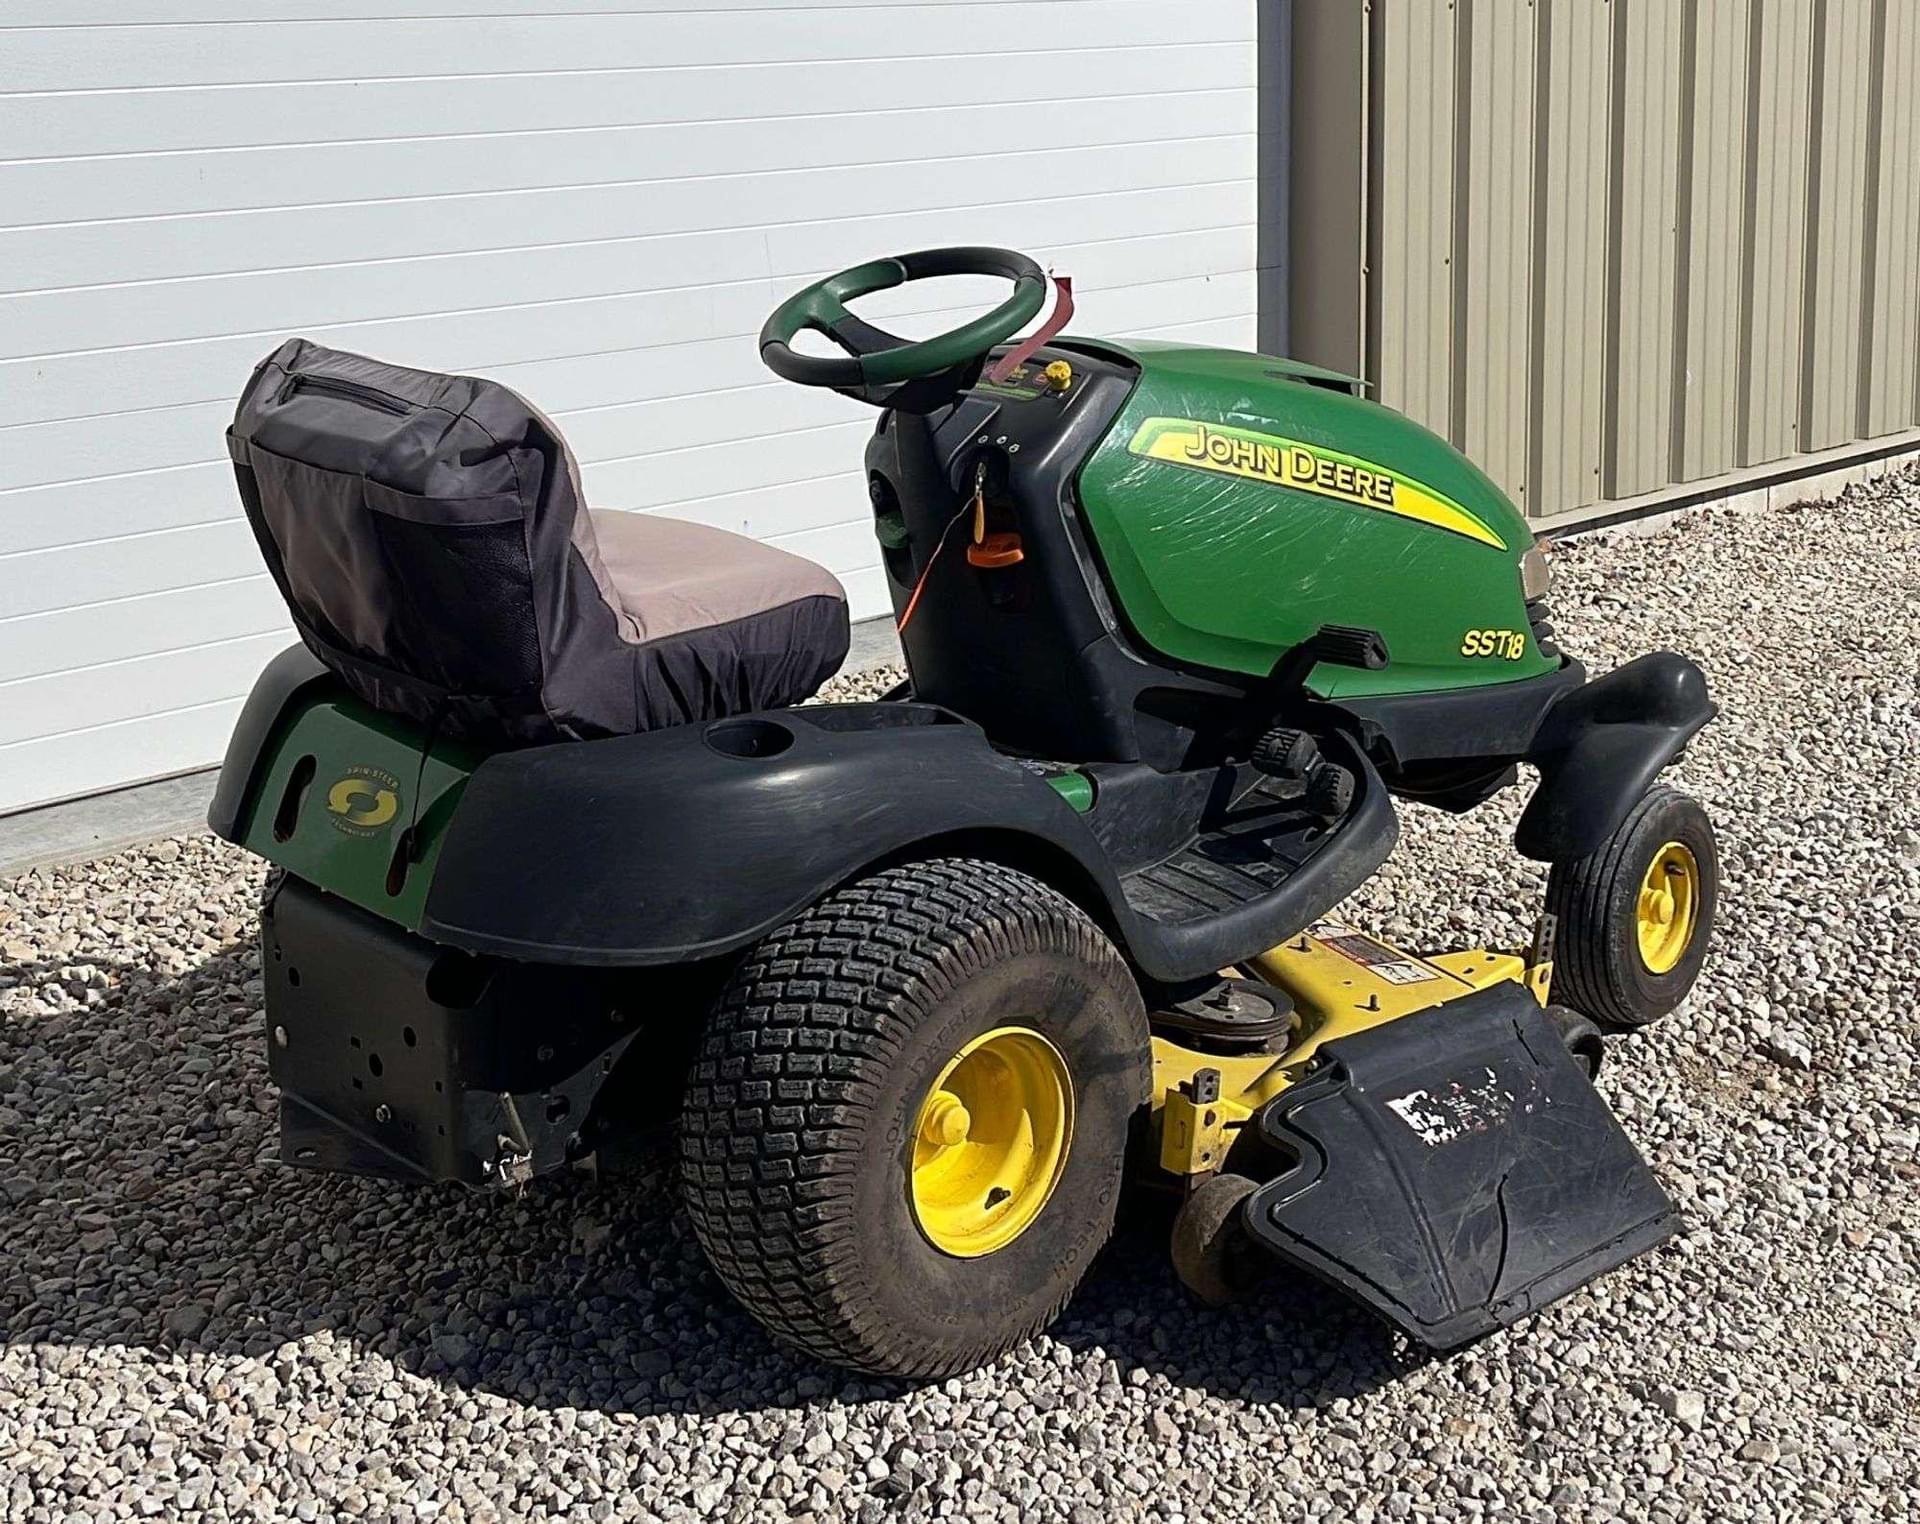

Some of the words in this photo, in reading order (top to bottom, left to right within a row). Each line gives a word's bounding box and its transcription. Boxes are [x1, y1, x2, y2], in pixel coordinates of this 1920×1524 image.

[1186, 425, 1281, 477] JOHN
[1290, 446, 1395, 505] DEERE
[1461, 629, 1526, 660] SST18
